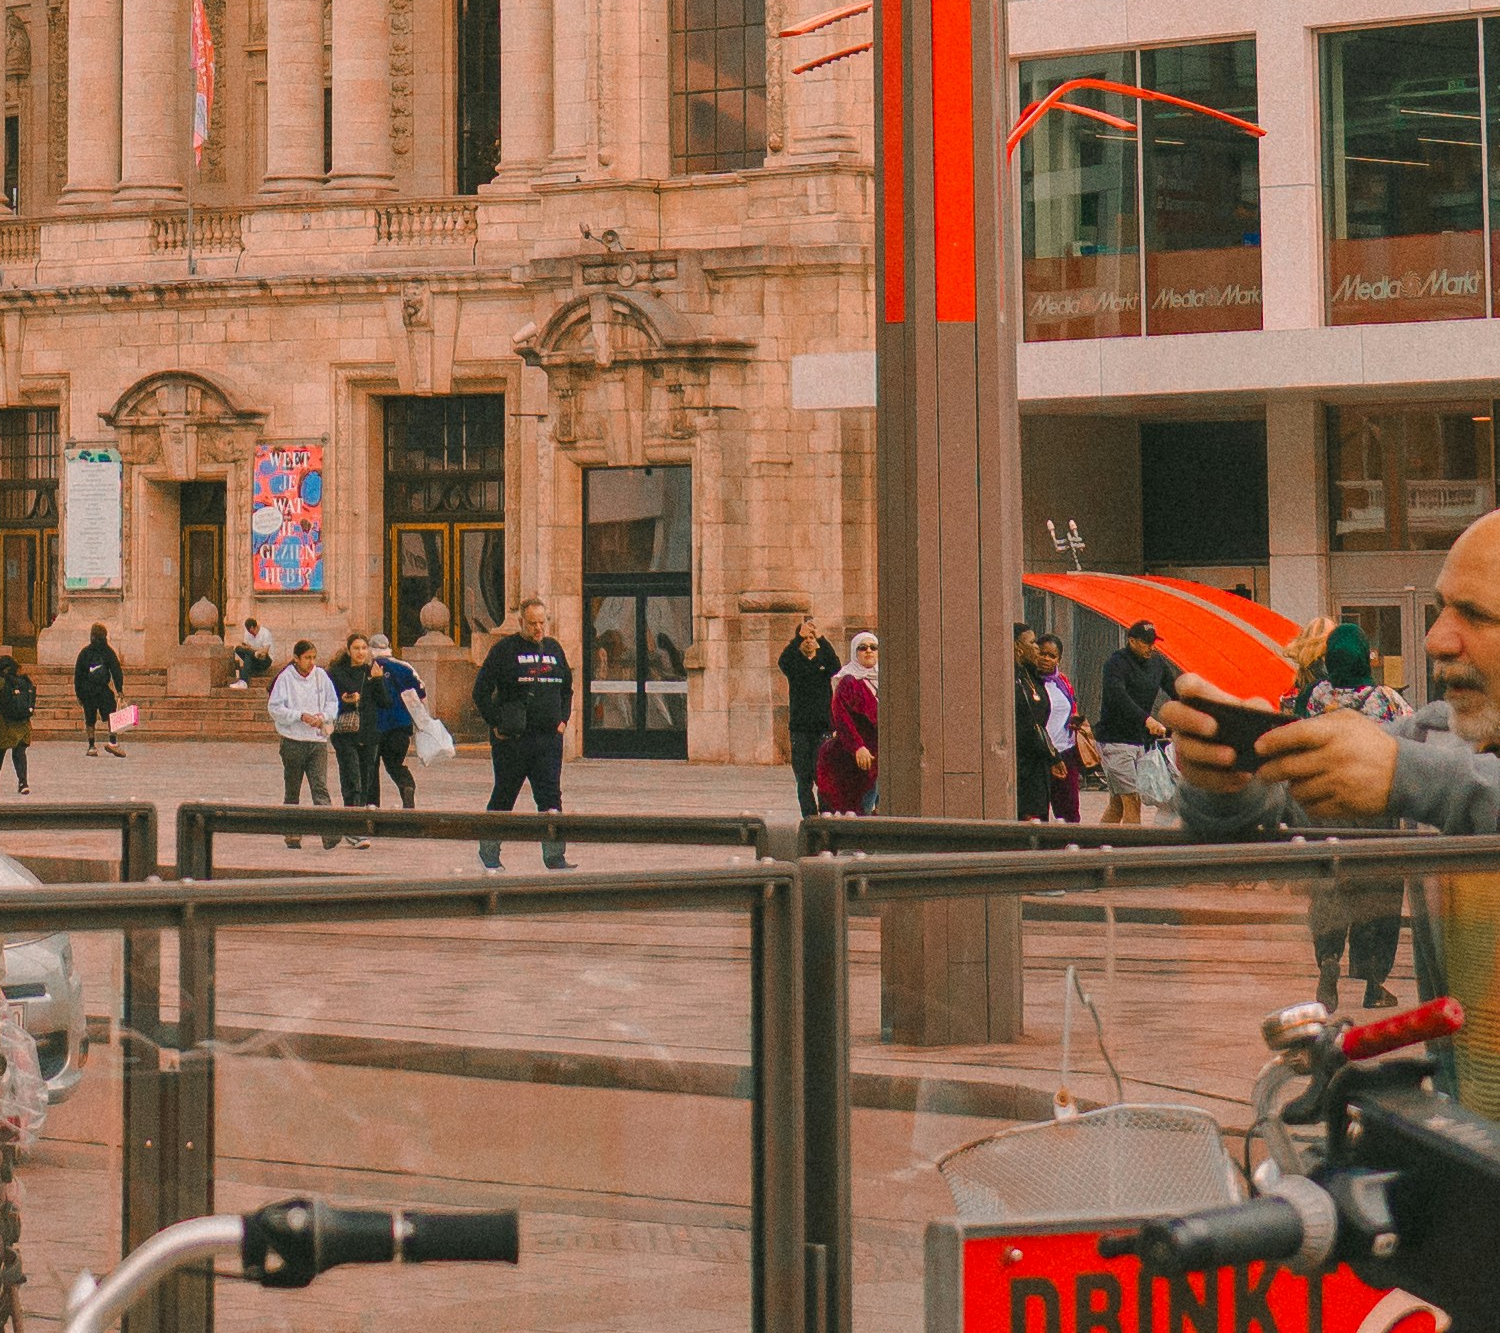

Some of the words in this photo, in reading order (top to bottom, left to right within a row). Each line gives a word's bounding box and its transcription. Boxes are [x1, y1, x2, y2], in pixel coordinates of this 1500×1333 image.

[1331, 274, 1402, 303] Media
[1417, 268, 1482, 298] Markt
[269, 450, 311, 468] WEET
[272, 496, 305, 515] WAT
